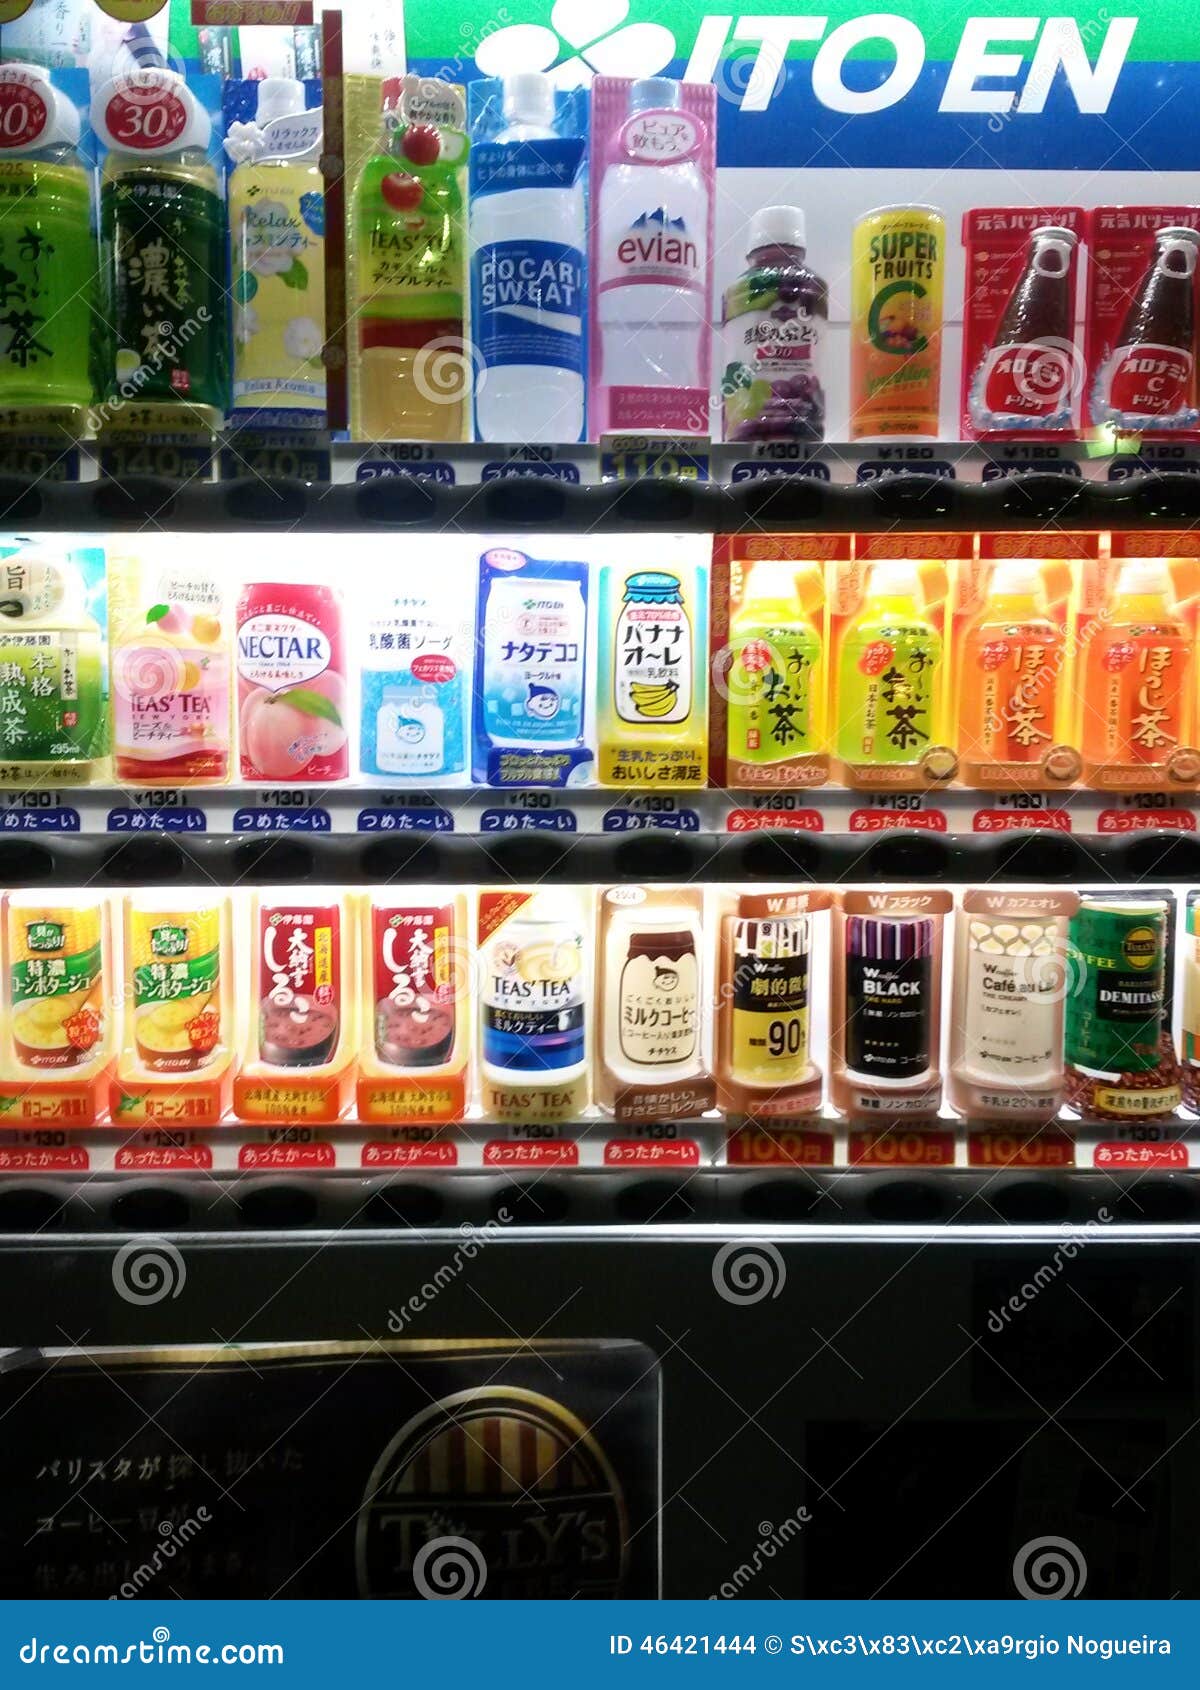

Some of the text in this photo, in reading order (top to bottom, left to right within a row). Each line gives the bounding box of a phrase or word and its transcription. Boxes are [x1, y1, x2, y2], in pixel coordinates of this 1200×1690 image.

[683, 14, 1139, 114] ITO EN
[0, 102, 29, 137] 0
[117, 105, 168, 138] 30
[617, 231, 698, 268] evian
[869, 232, 938, 264] SUPER
[480, 258, 582, 288] POCARI
[872, 260, 934, 282] FRUITS
[481, 282, 577, 308] SWEAT
[867, 280, 930, 356] C
[1120, 356, 1188, 383] オロナミン
[1148, 376, 1167, 393] C
[622, 622, 685, 646] バナナ
[238, 635, 324, 661] NECTAR
[29, 652, 57, 698] 本格
[0, 661, 29, 746] 熟成茶
[130, 693, 211, 714] TEAS' TEA
[1007, 645, 1052, 746] ほうじ茶
[1130, 645, 1178, 748] ほうじ茶
[611, 763, 702, 782] おいしさ満足
[868, 894, 886, 909] W
[986, 895, 1005, 908] W
[26, 959, 67, 978] 特濃
[150, 962, 190, 980] 特濃
[263, 926, 311, 1024] しるこ
[382, 927, 432, 1024] しるこ
[11, 975, 92, 997] コーンポタージュ
[491, 974, 572, 998] TEAS' TEA
[862, 979, 922, 997] BLACK
[982, 976, 1017, 993] Café
[768, 1018, 801, 1057] 90
[490, 1090, 574, 1108] TEAS' TEA
